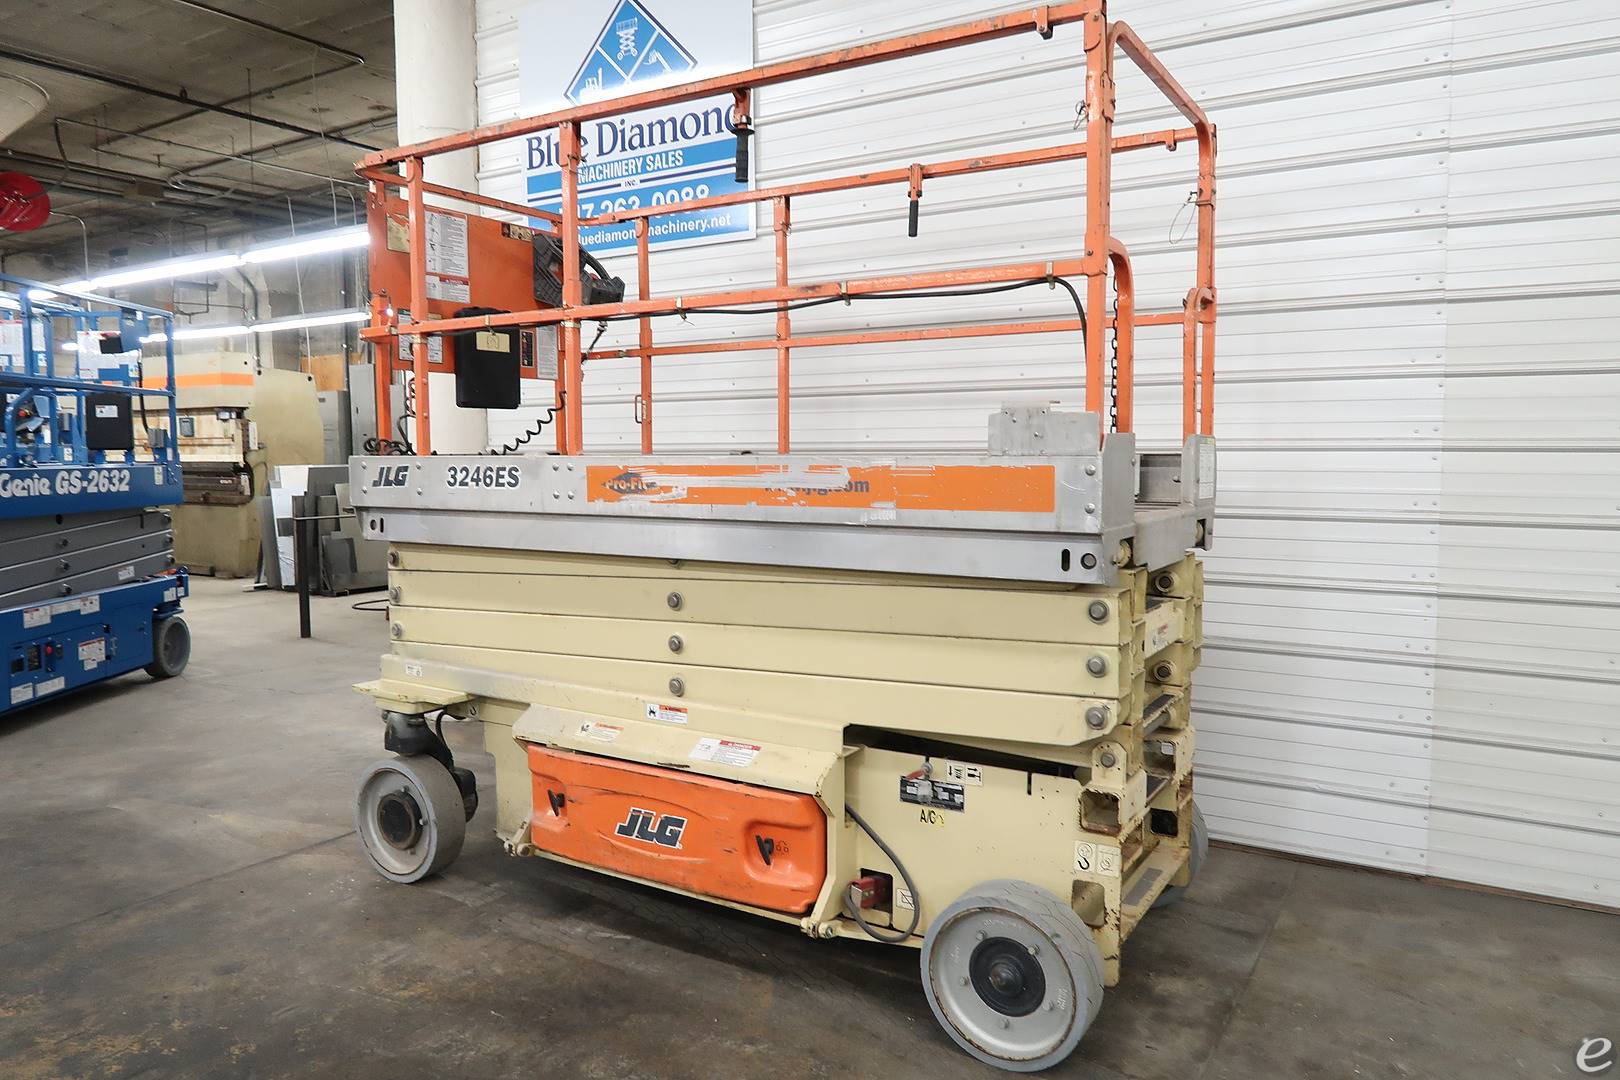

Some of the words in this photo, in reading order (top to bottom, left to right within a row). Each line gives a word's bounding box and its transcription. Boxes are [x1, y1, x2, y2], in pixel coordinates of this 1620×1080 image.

[578, 156, 644, 184] MACHINERY
[646, 149, 684, 173] SALES
[0, 472, 52, 498] Genie
[55, 469, 130, 495] GS-2632
[372, 465, 409, 487] JLG
[446, 465, 520, 488] 3246ES
[614, 806, 688, 849] JLG
